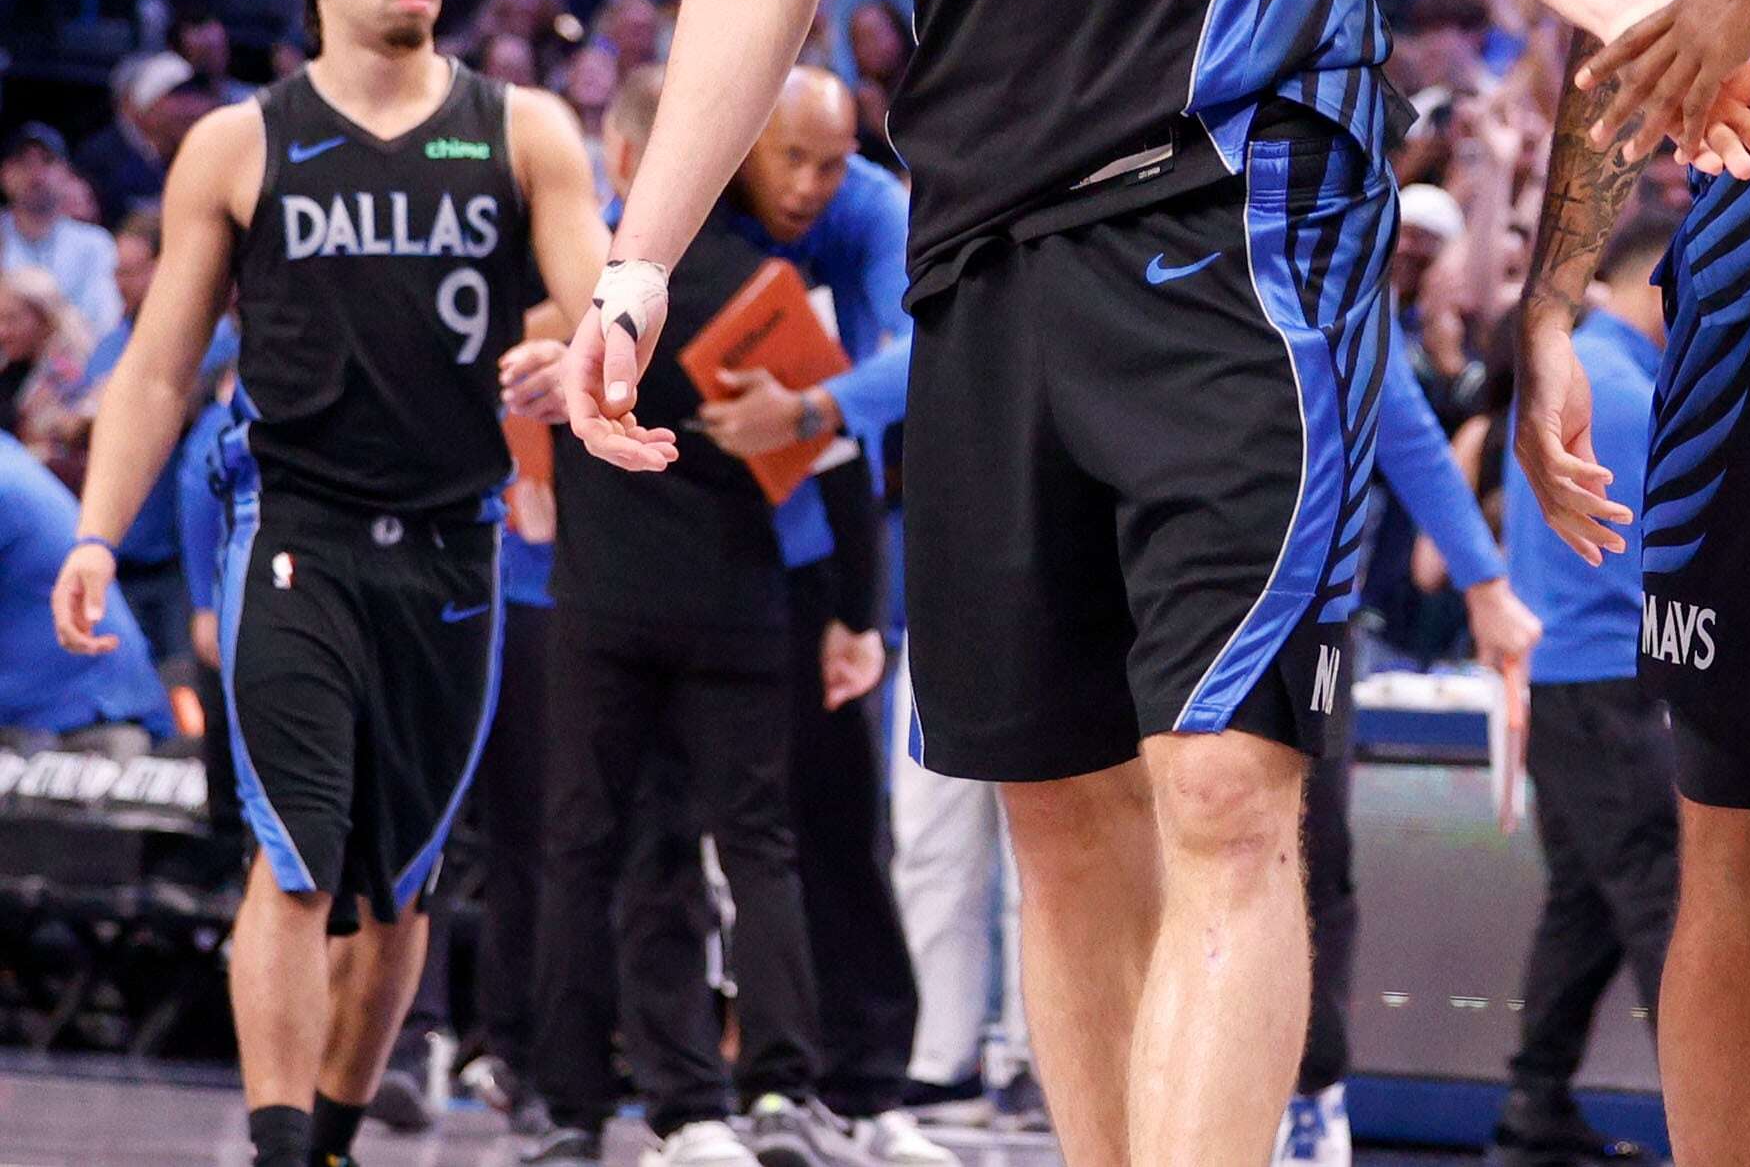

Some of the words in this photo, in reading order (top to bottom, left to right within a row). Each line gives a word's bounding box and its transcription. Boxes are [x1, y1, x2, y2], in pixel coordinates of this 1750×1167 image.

[281, 191, 499, 261] DALLAS
[436, 267, 490, 364] 9
[1641, 591, 1716, 670] MAVS
